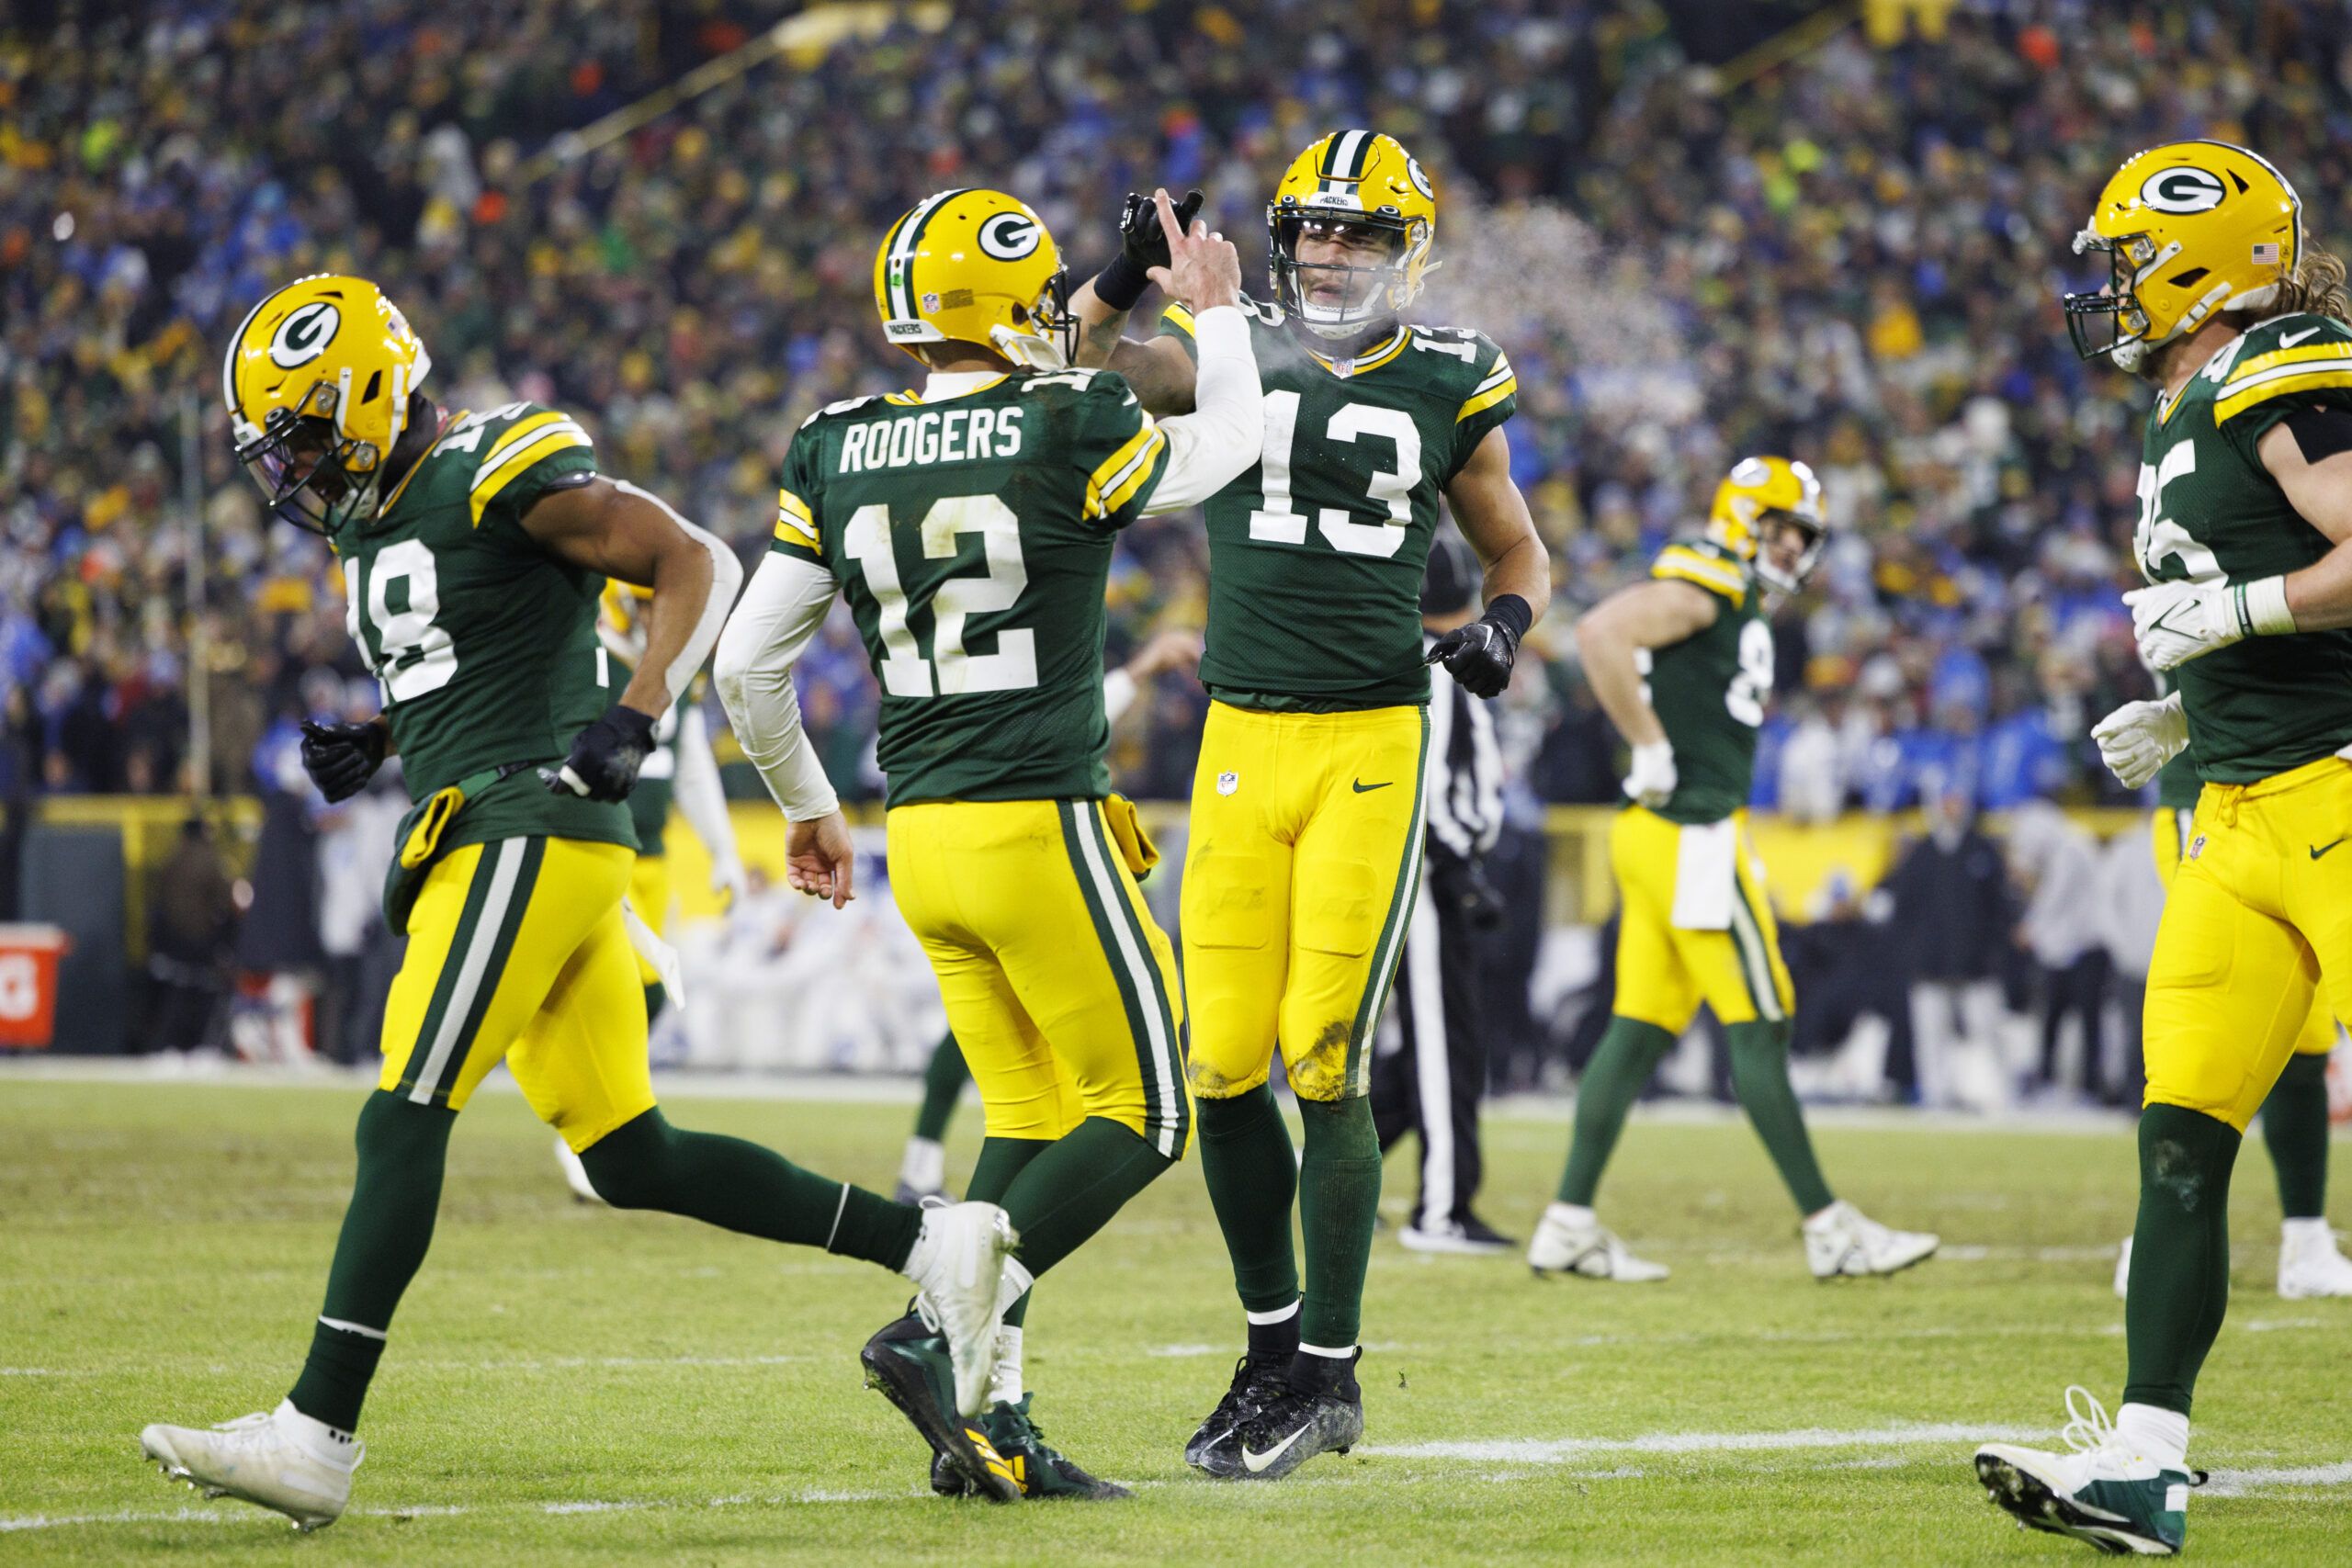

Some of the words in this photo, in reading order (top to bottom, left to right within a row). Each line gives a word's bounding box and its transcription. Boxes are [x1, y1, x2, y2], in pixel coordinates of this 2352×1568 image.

[1319, 196, 1349, 207] PACKERS
[2139, 165, 2227, 216] G
[978, 211, 1040, 263] G
[270, 301, 341, 371] G
[888, 322, 922, 335] PACKERS
[839, 406, 1023, 474] RODGERS
[1250, 389, 1423, 558] 13
[345, 538, 458, 709] 18
[844, 494, 1038, 698] 12
